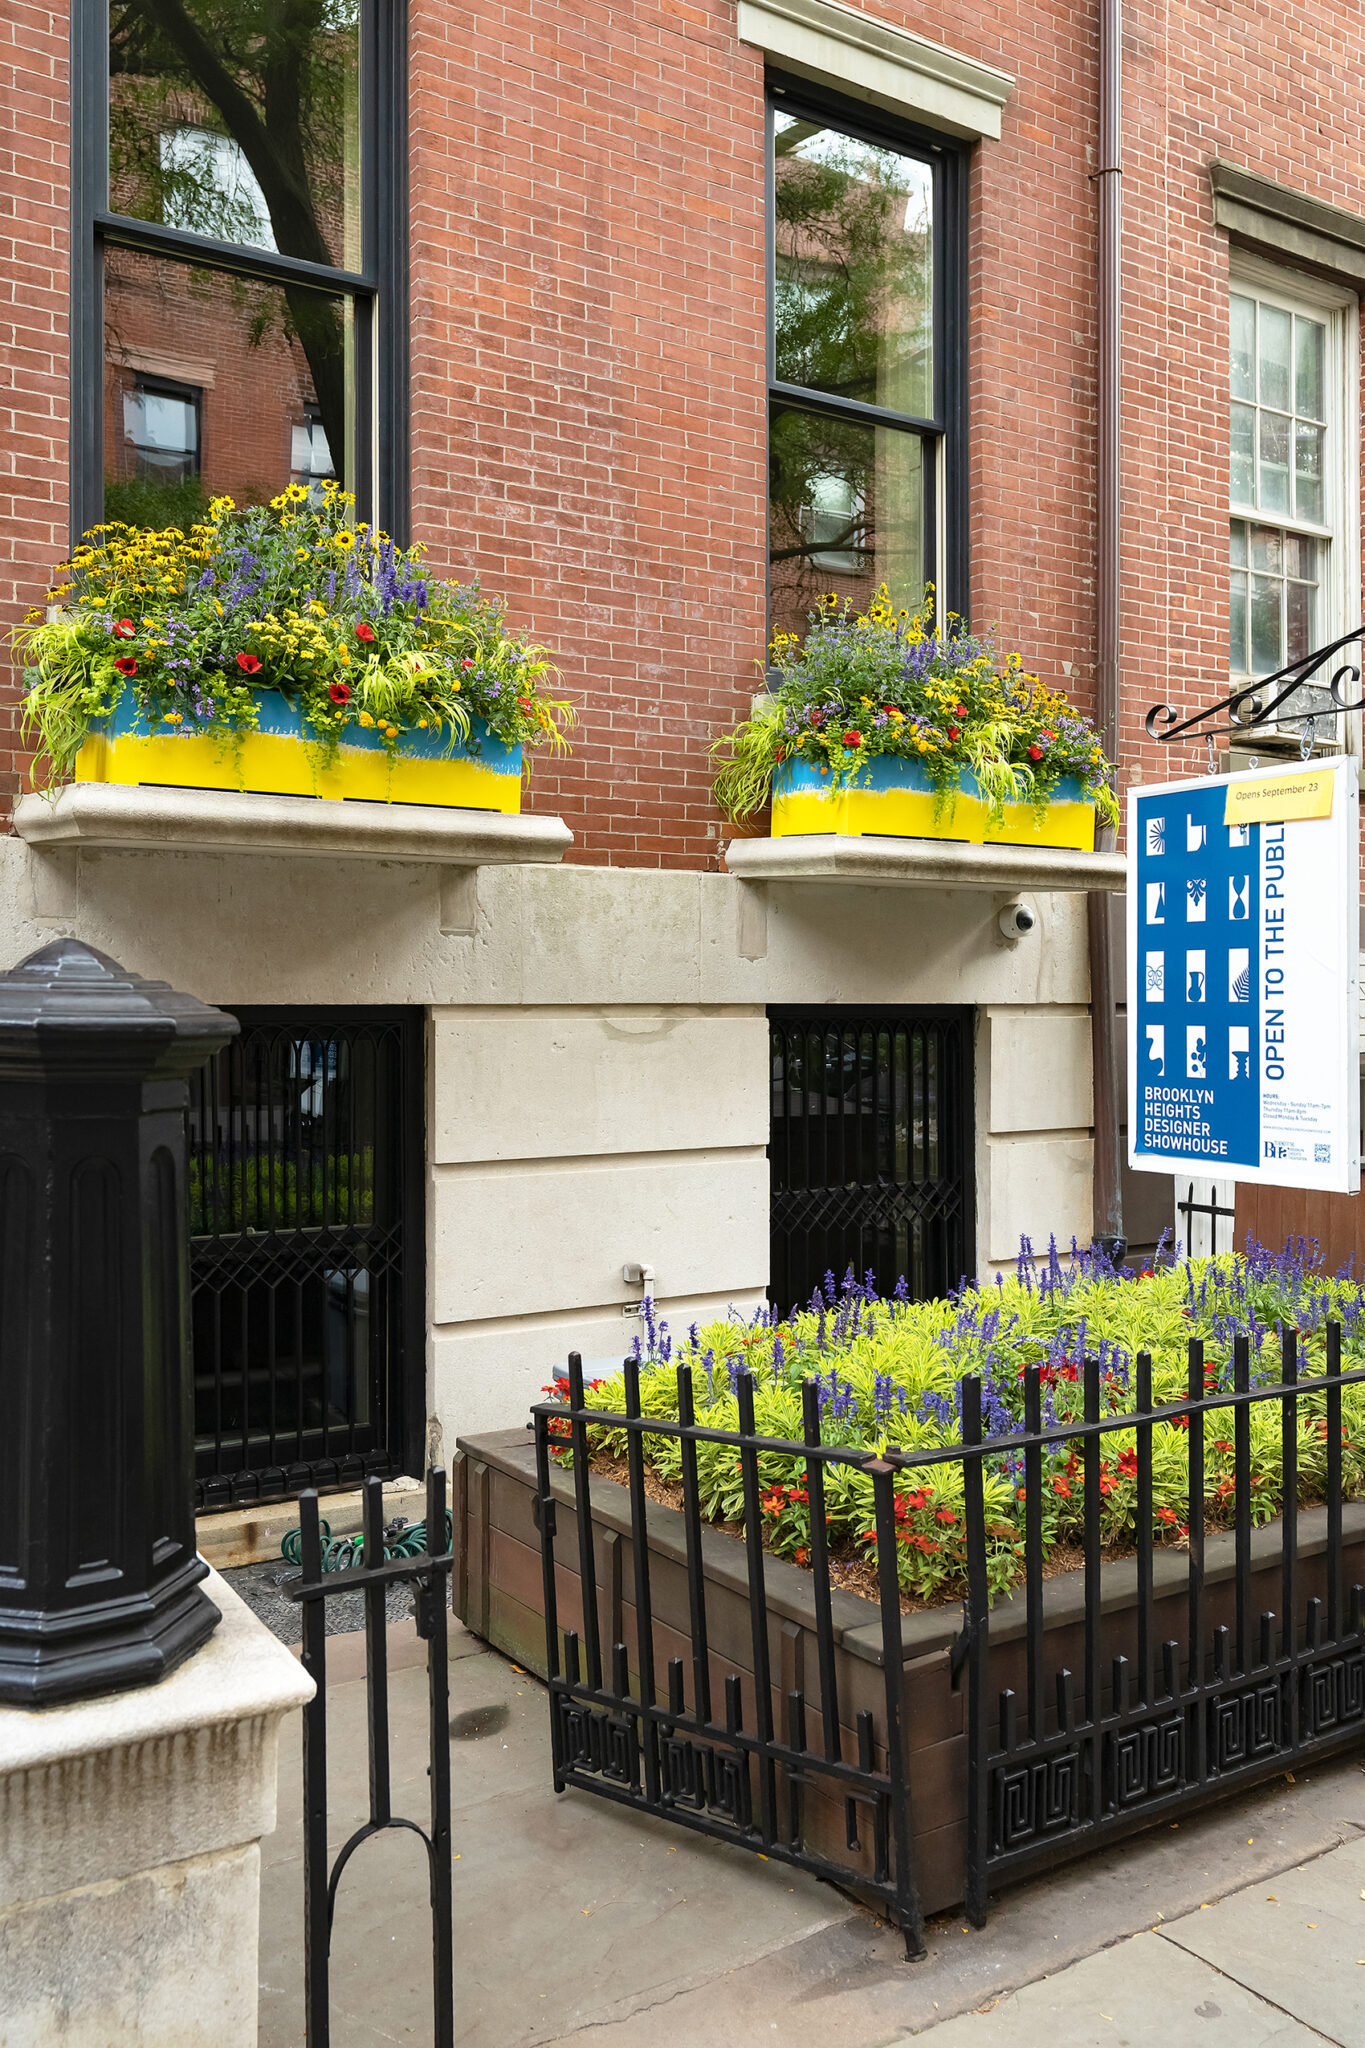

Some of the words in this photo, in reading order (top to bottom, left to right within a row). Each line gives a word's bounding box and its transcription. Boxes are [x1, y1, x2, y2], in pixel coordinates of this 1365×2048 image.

[1236, 791, 1260, 801] Opens
[1262, 785, 1306, 798] September
[1308, 783, 1319, 792] 23
[1265, 821, 1284, 899] PUBLI
[1265, 908, 1284, 960] THE
[1265, 968, 1284, 1000] TO
[1265, 1009, 1284, 1081] OPEN
[1144, 1086, 1214, 1105] BROOKLYN
[1144, 1101, 1201, 1120] HEIGHTS
[1144, 1117, 1211, 1137] DESIGNER
[1144, 1133, 1228, 1155] SHOWHOUSE
